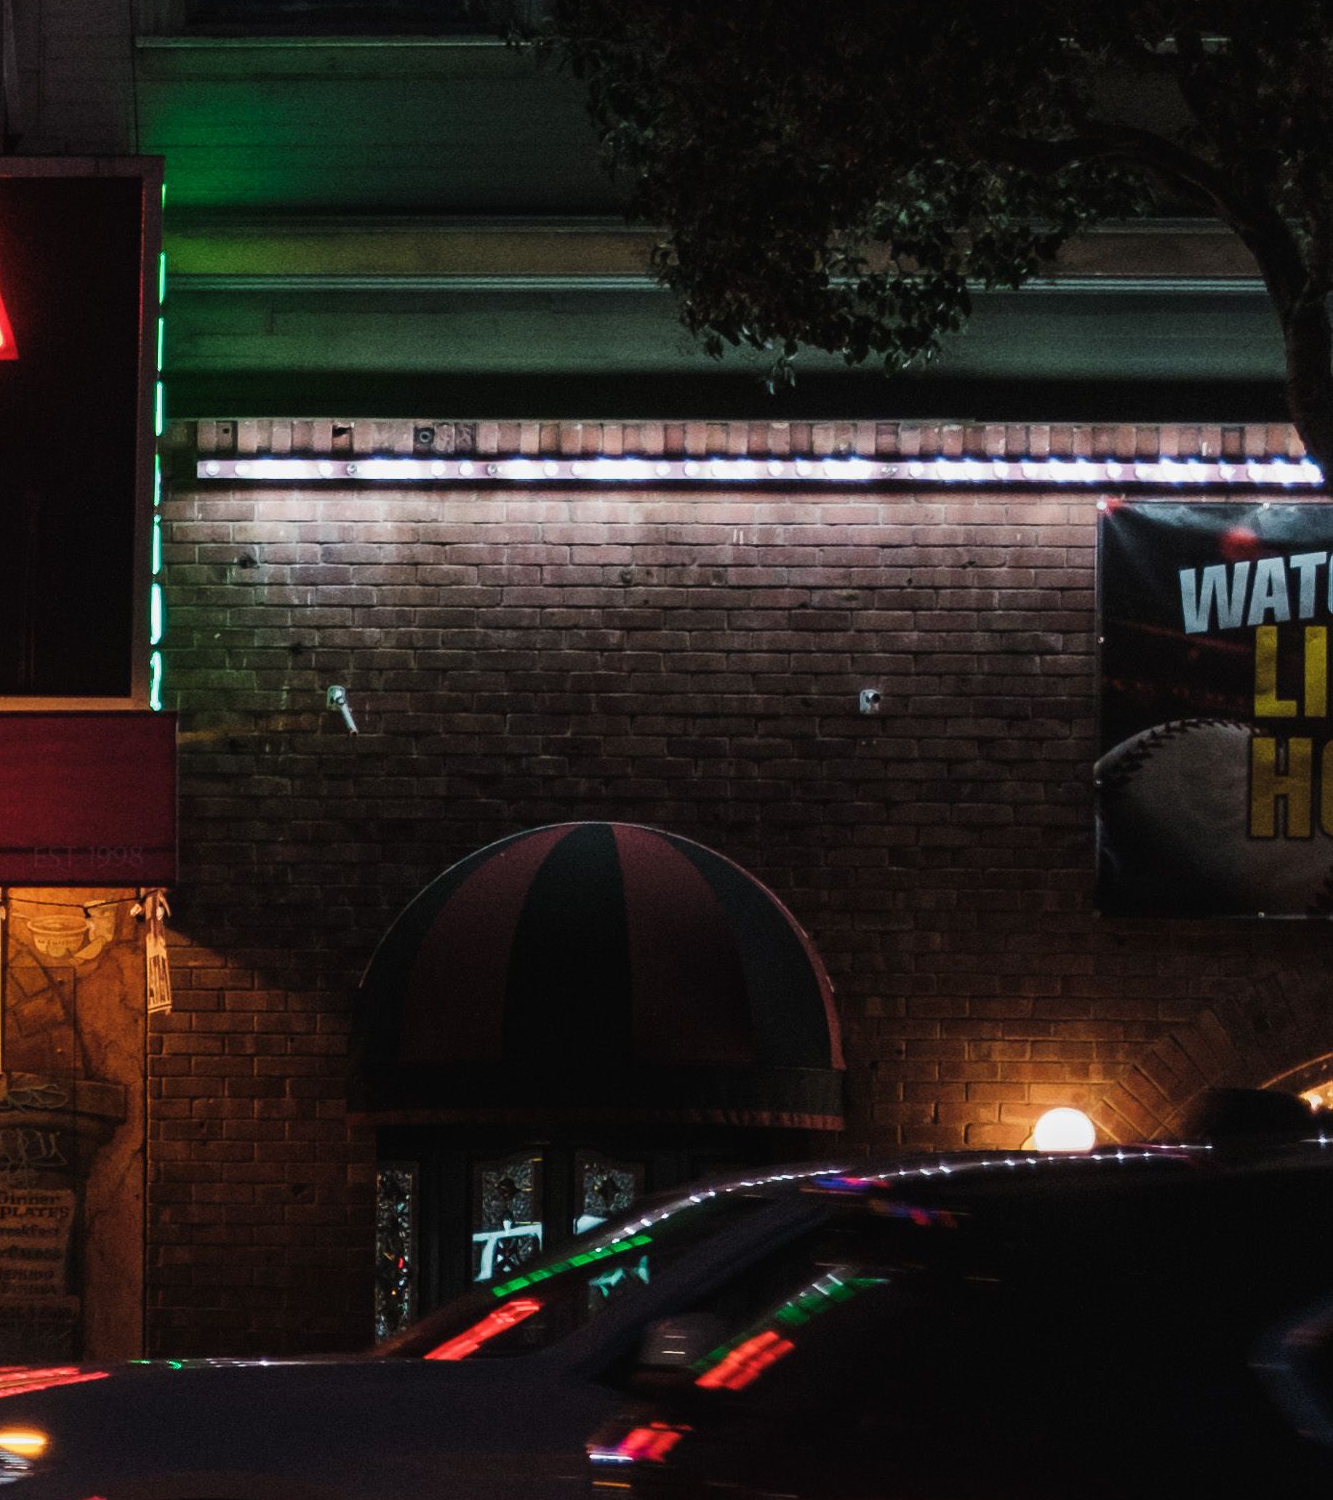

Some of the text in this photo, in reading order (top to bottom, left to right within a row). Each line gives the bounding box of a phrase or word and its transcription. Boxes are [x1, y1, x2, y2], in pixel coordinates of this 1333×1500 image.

[1179, 551, 1333, 635] WAT
[1249, 737, 1333, 838] H
[88, 846, 144, 868] 1998
[0, 1206, 69, 1219] PLATES
